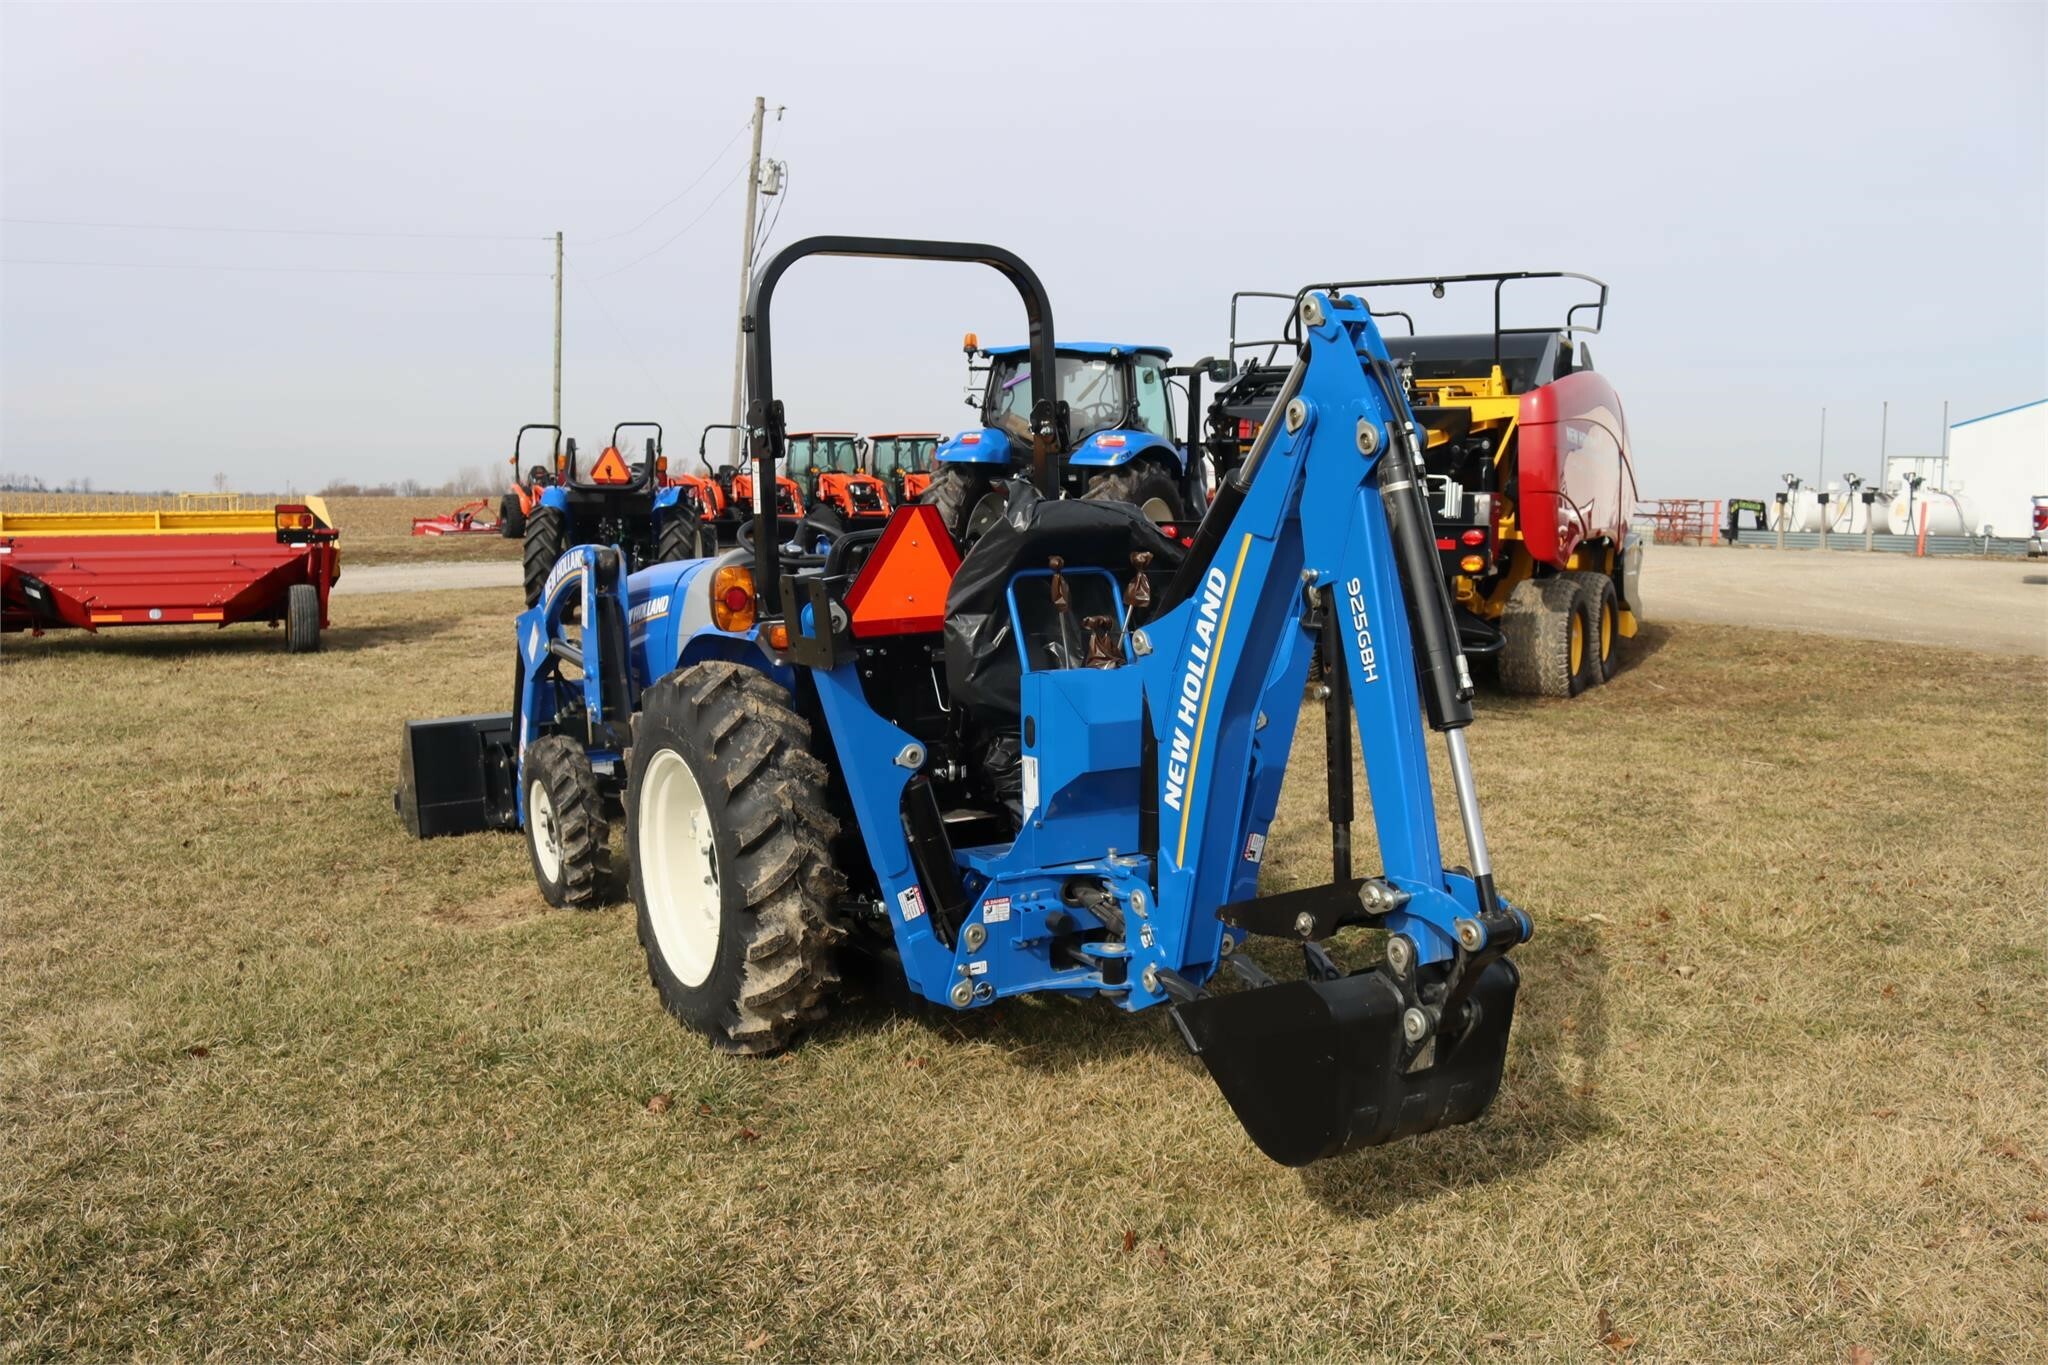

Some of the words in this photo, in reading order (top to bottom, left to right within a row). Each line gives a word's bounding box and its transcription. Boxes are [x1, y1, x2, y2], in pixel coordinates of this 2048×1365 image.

[633, 595, 670, 623] HOLLAND
[1346, 577, 1379, 683] 925GBH
[1164, 727, 1190, 811] NEW
[1177, 567, 1226, 728] HOLLAND
